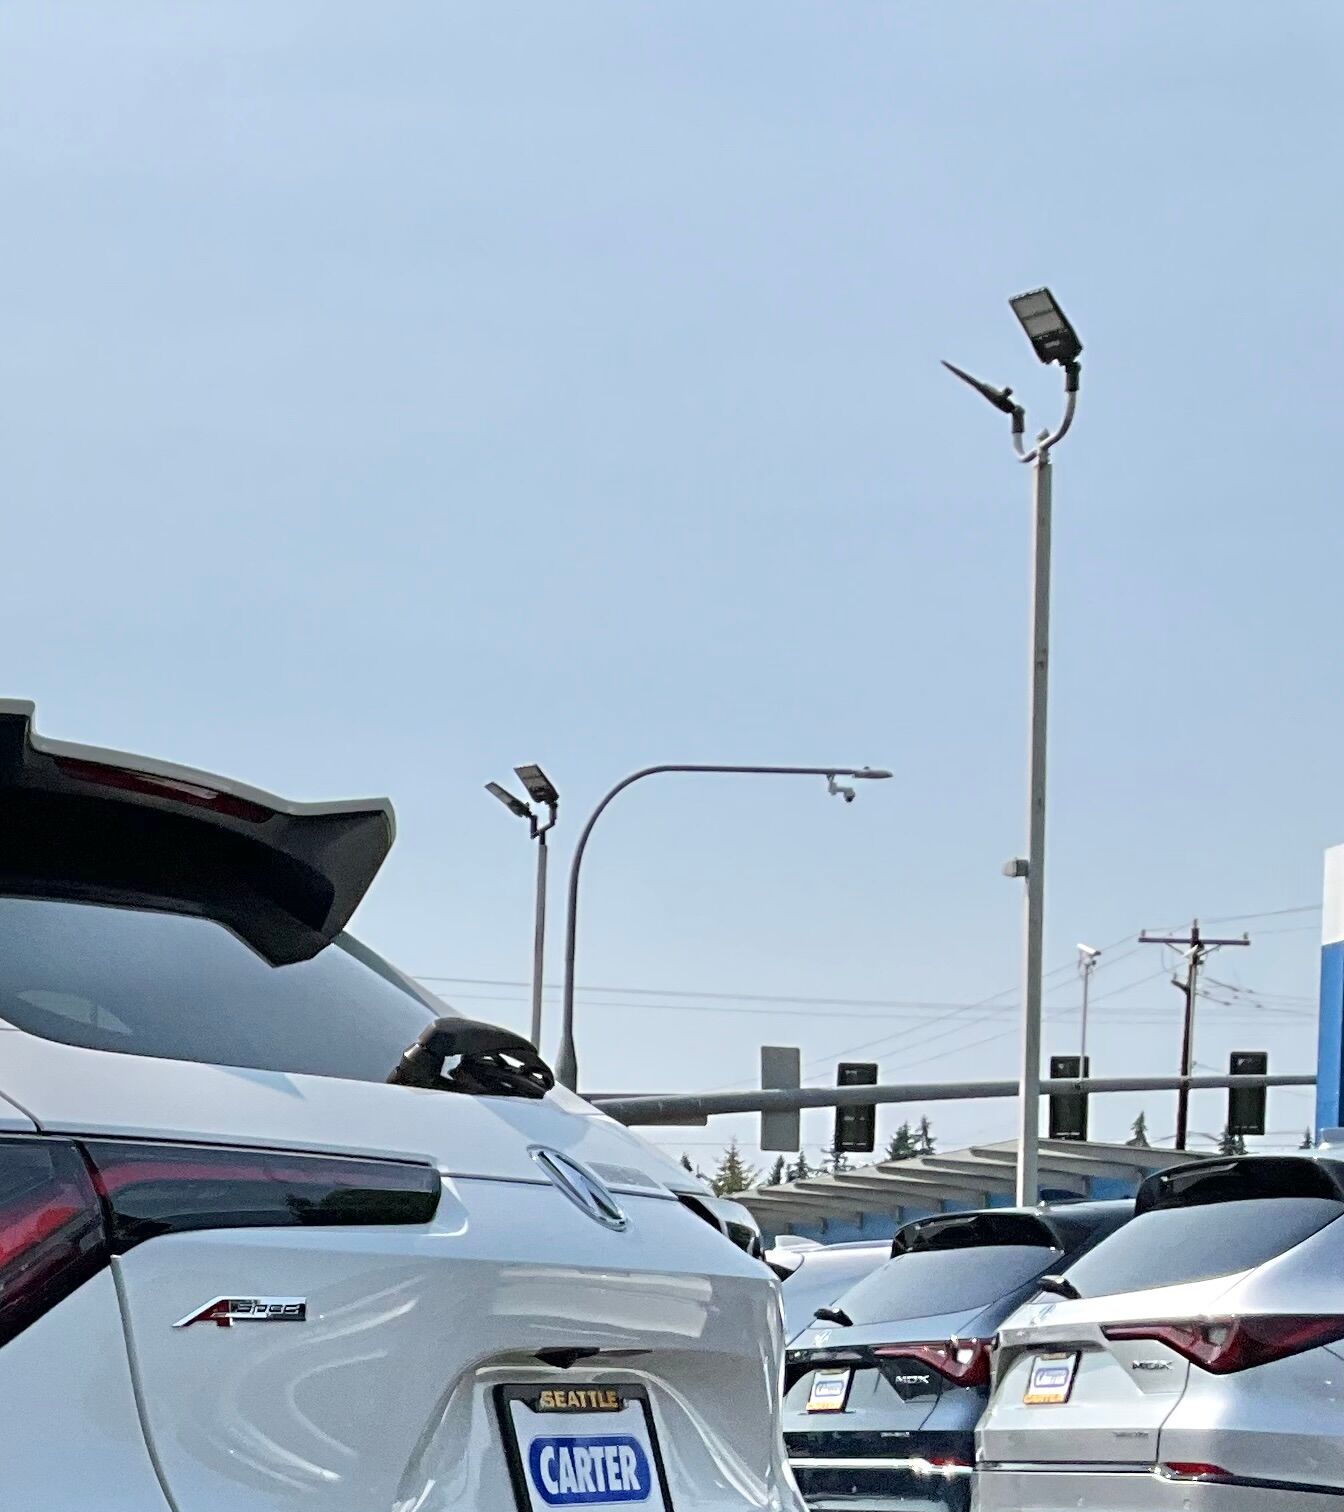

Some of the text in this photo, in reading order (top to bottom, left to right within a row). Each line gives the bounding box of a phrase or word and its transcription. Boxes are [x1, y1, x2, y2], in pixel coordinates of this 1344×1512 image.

[895, 1374, 930, 1385] MDX
[539, 1390, 619, 1409] SEATTLE
[539, 1445, 642, 1496] CARTER
